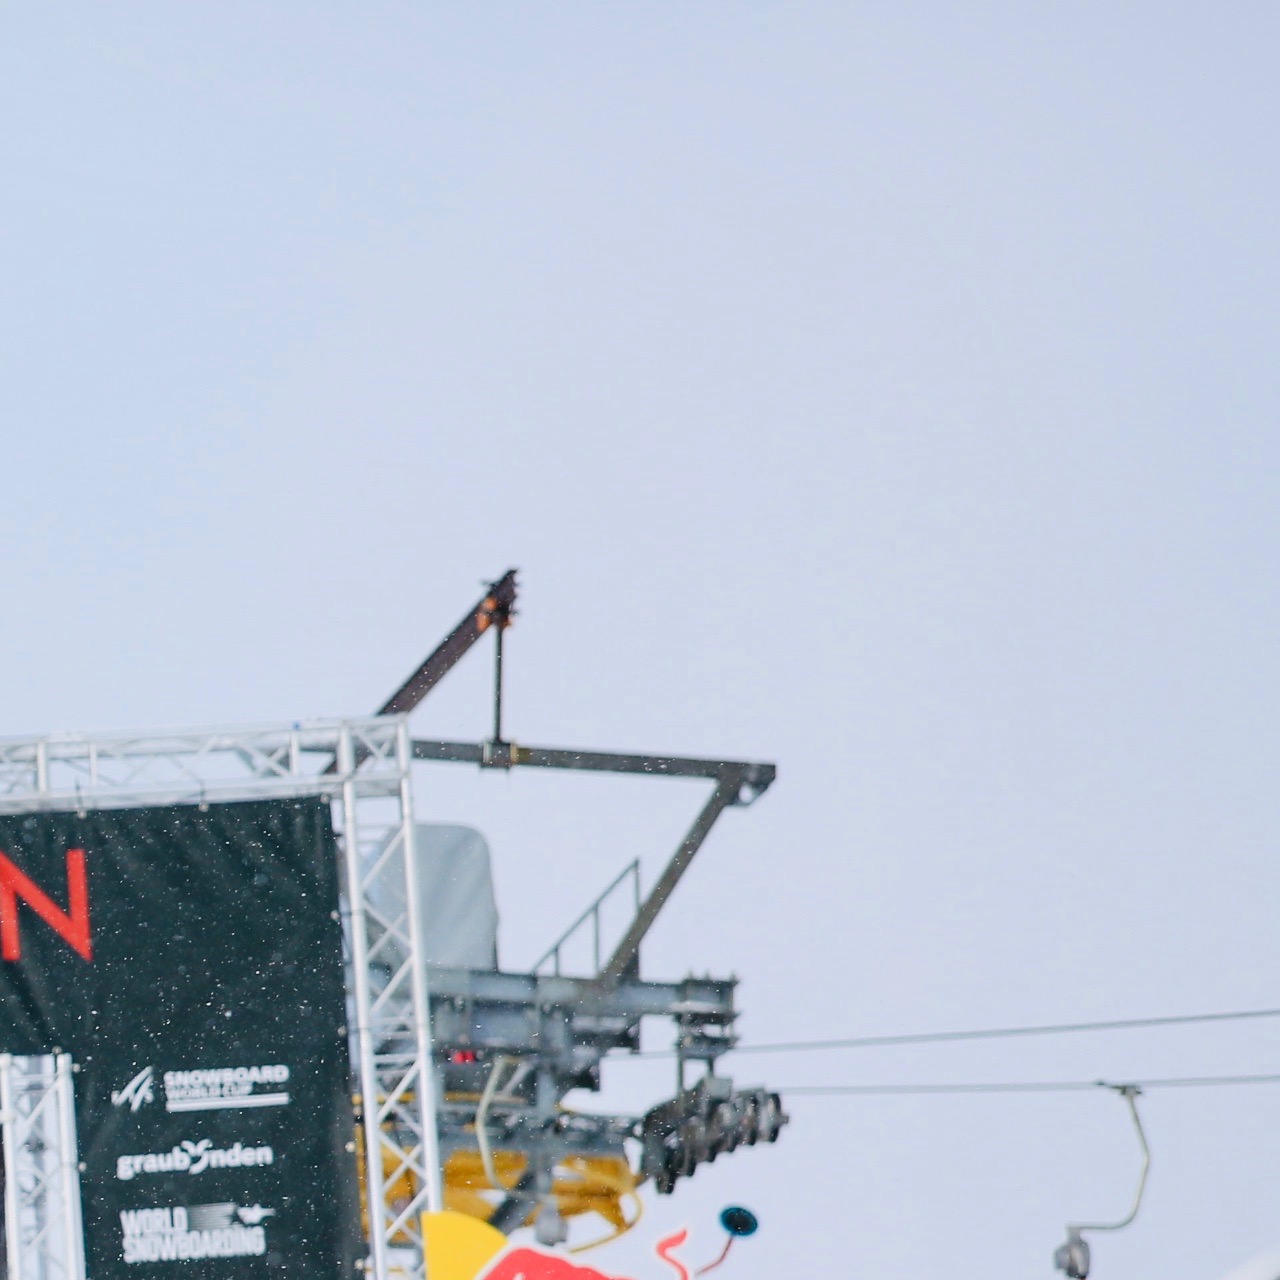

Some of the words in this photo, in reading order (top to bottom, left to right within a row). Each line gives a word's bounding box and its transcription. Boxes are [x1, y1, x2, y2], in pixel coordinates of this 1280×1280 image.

[162, 1064, 290, 1088] SNOWBOARD
[120, 1206, 189, 1236] WORLD
[122, 1225, 267, 1264] SNOWBOARDING
